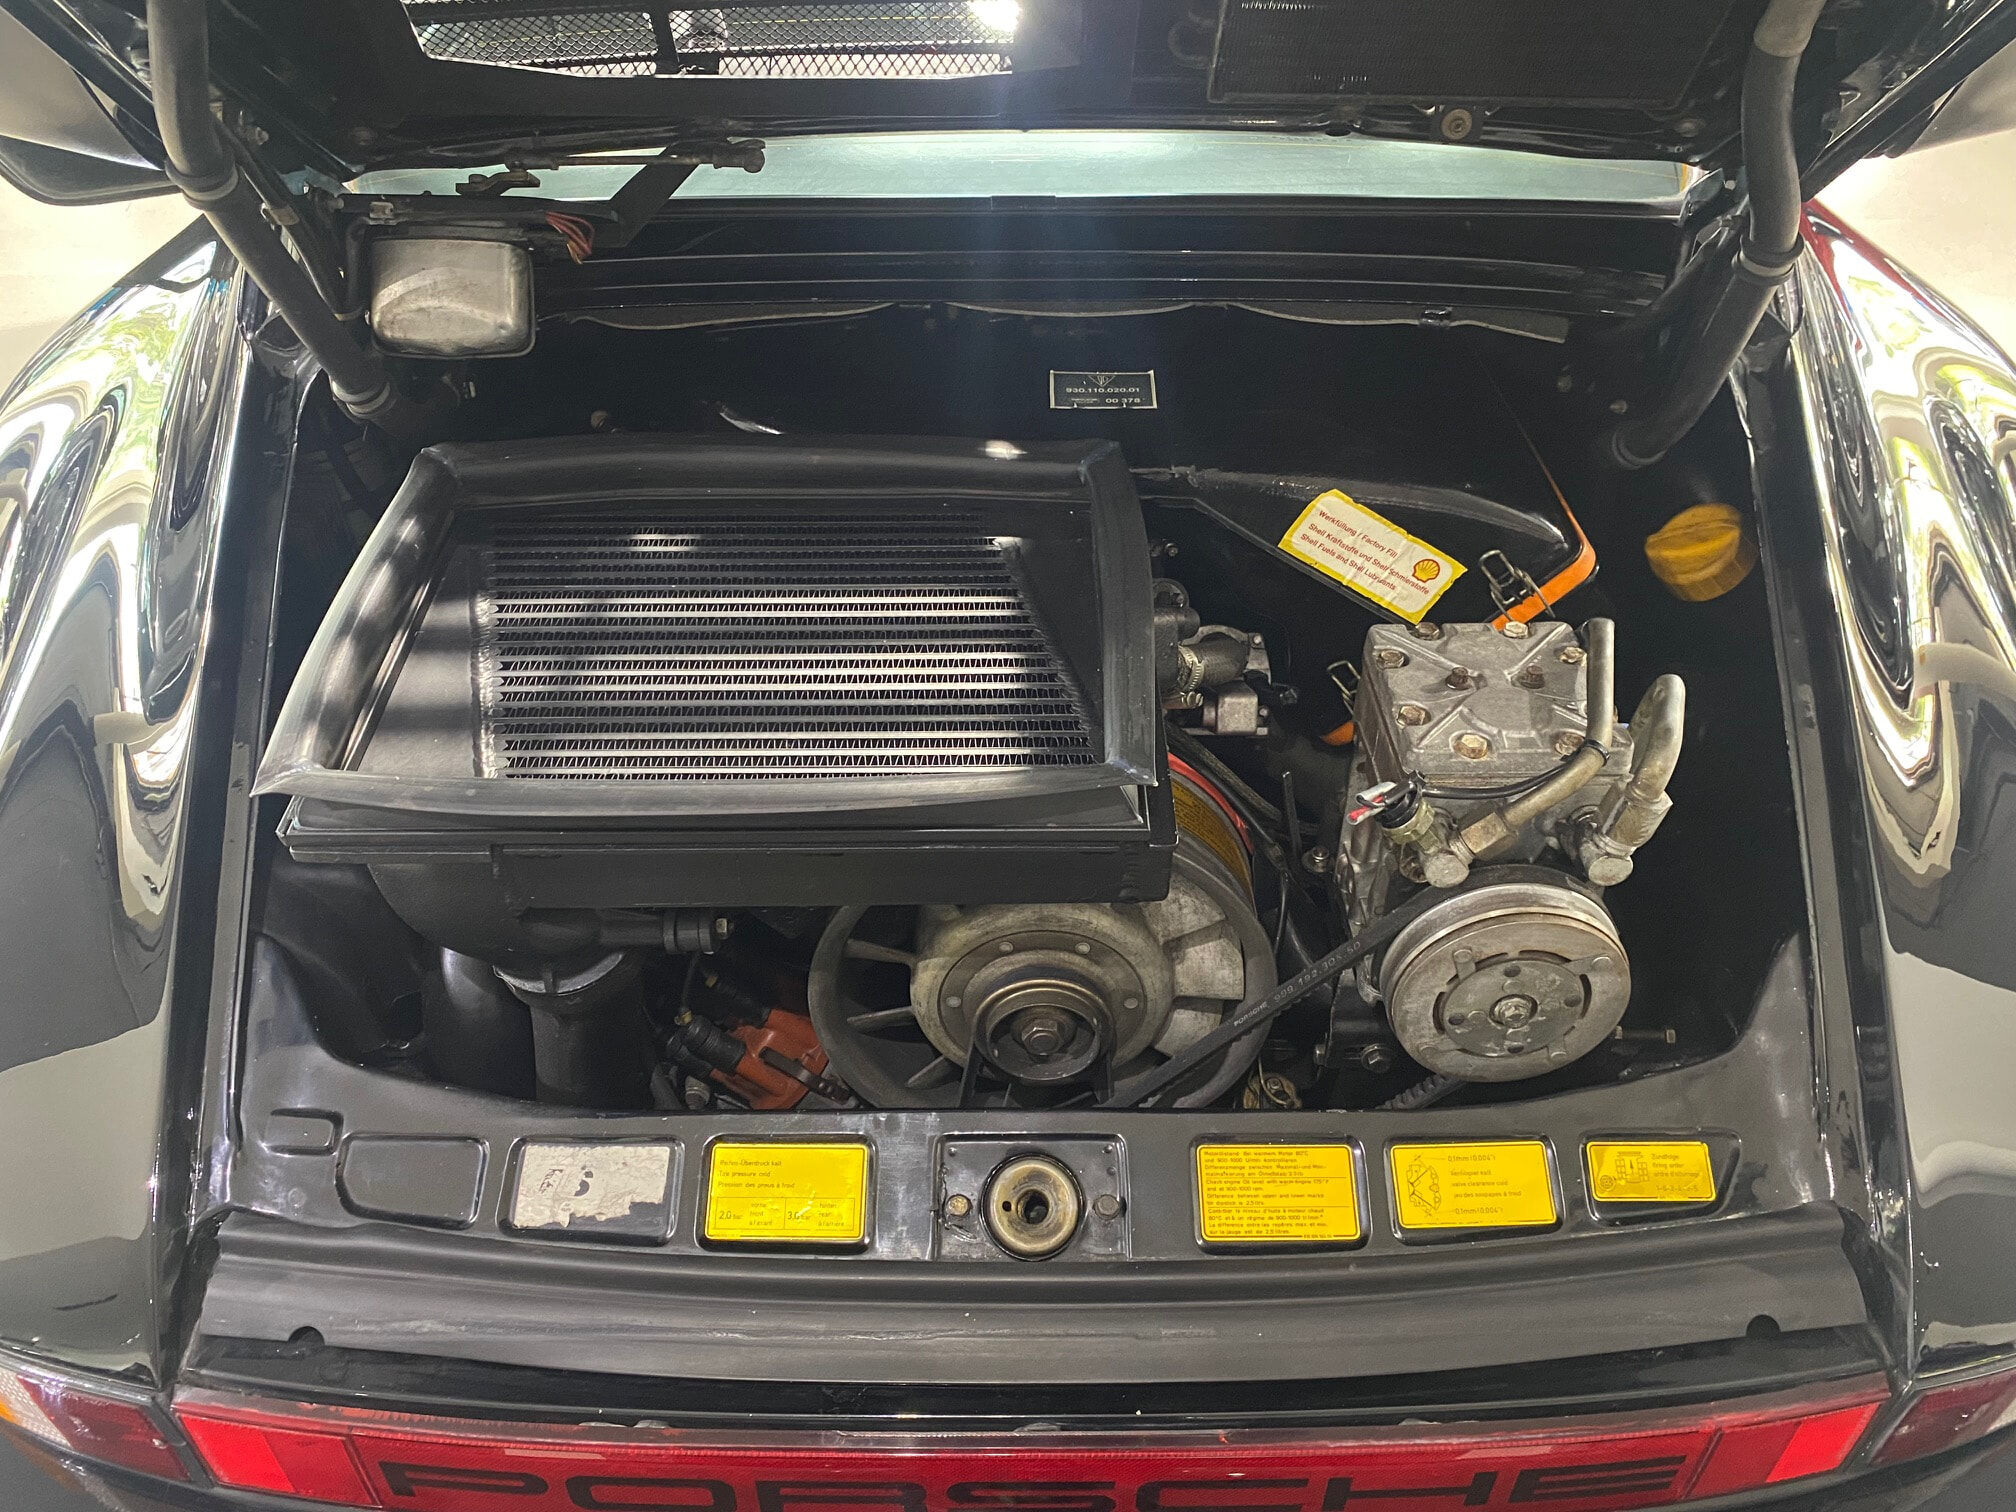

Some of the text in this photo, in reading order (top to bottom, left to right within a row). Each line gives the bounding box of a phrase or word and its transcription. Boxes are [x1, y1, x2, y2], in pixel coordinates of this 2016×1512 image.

[1300, 533, 1319, 547] Shell
[1317, 542, 1336, 557] Fuels
[1336, 554, 1350, 565] and
[1308, 523, 1430, 595] Shell Kraftstoffe und Shell Schmierstoffe
[1319, 510, 1357, 537] Werkfüllung
[1361, 534, 1386, 552] Factory
[1386, 548, 1398, 559] Fill
[379, 1455, 1686, 1512] PORSCHE
